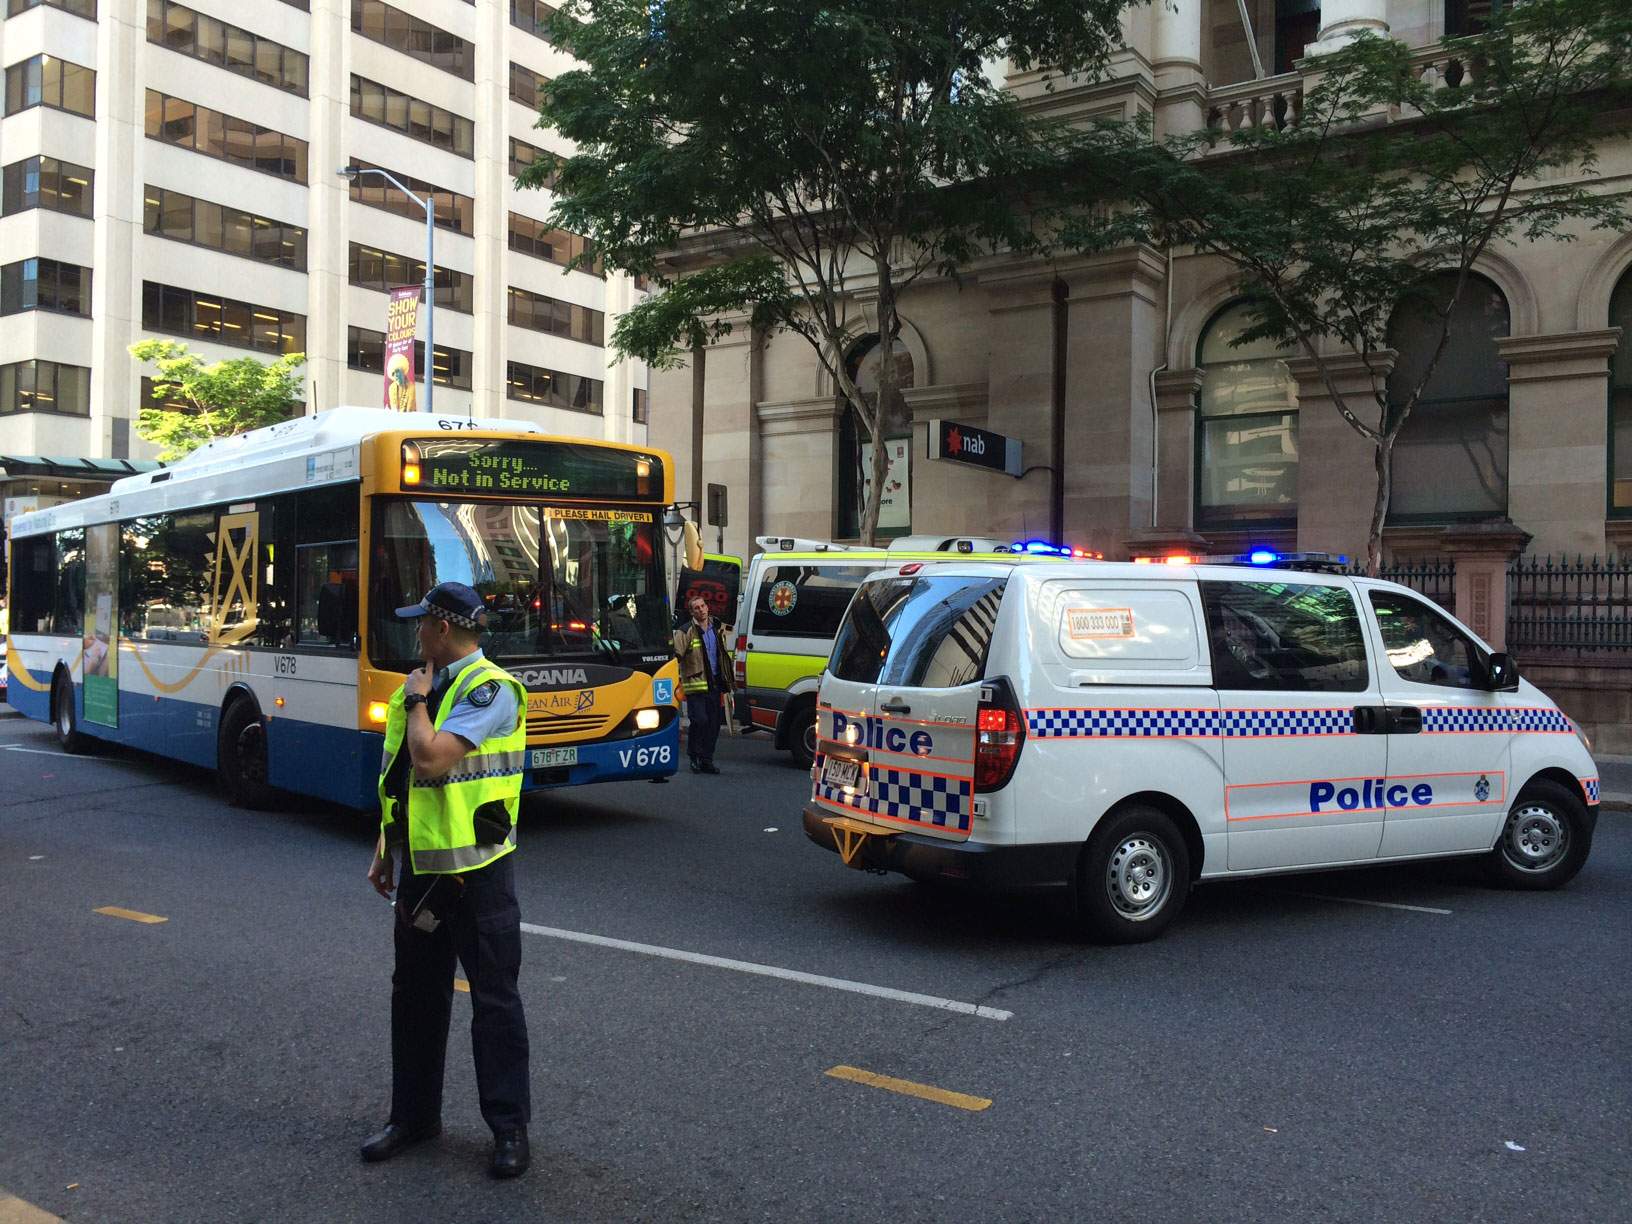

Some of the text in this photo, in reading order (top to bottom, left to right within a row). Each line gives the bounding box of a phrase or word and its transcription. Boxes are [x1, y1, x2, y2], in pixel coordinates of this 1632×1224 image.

[388, 296, 418, 316] SHOW
[388, 312, 416, 331] YOUR
[388, 327, 416, 341] COLOURS
[963, 434, 985, 455] nab
[433, 468, 570, 491] Not in Service
[554, 509, 645, 521] PLEASE HAIL DRIVER
[1072, 616, 1089, 630] 1800
[1090, 615, 1104, 630] 333
[274, 656, 297, 675] V678
[832, 711, 933, 757] Police
[636, 745, 671, 767] 678
[1309, 778, 1433, 812] Police
